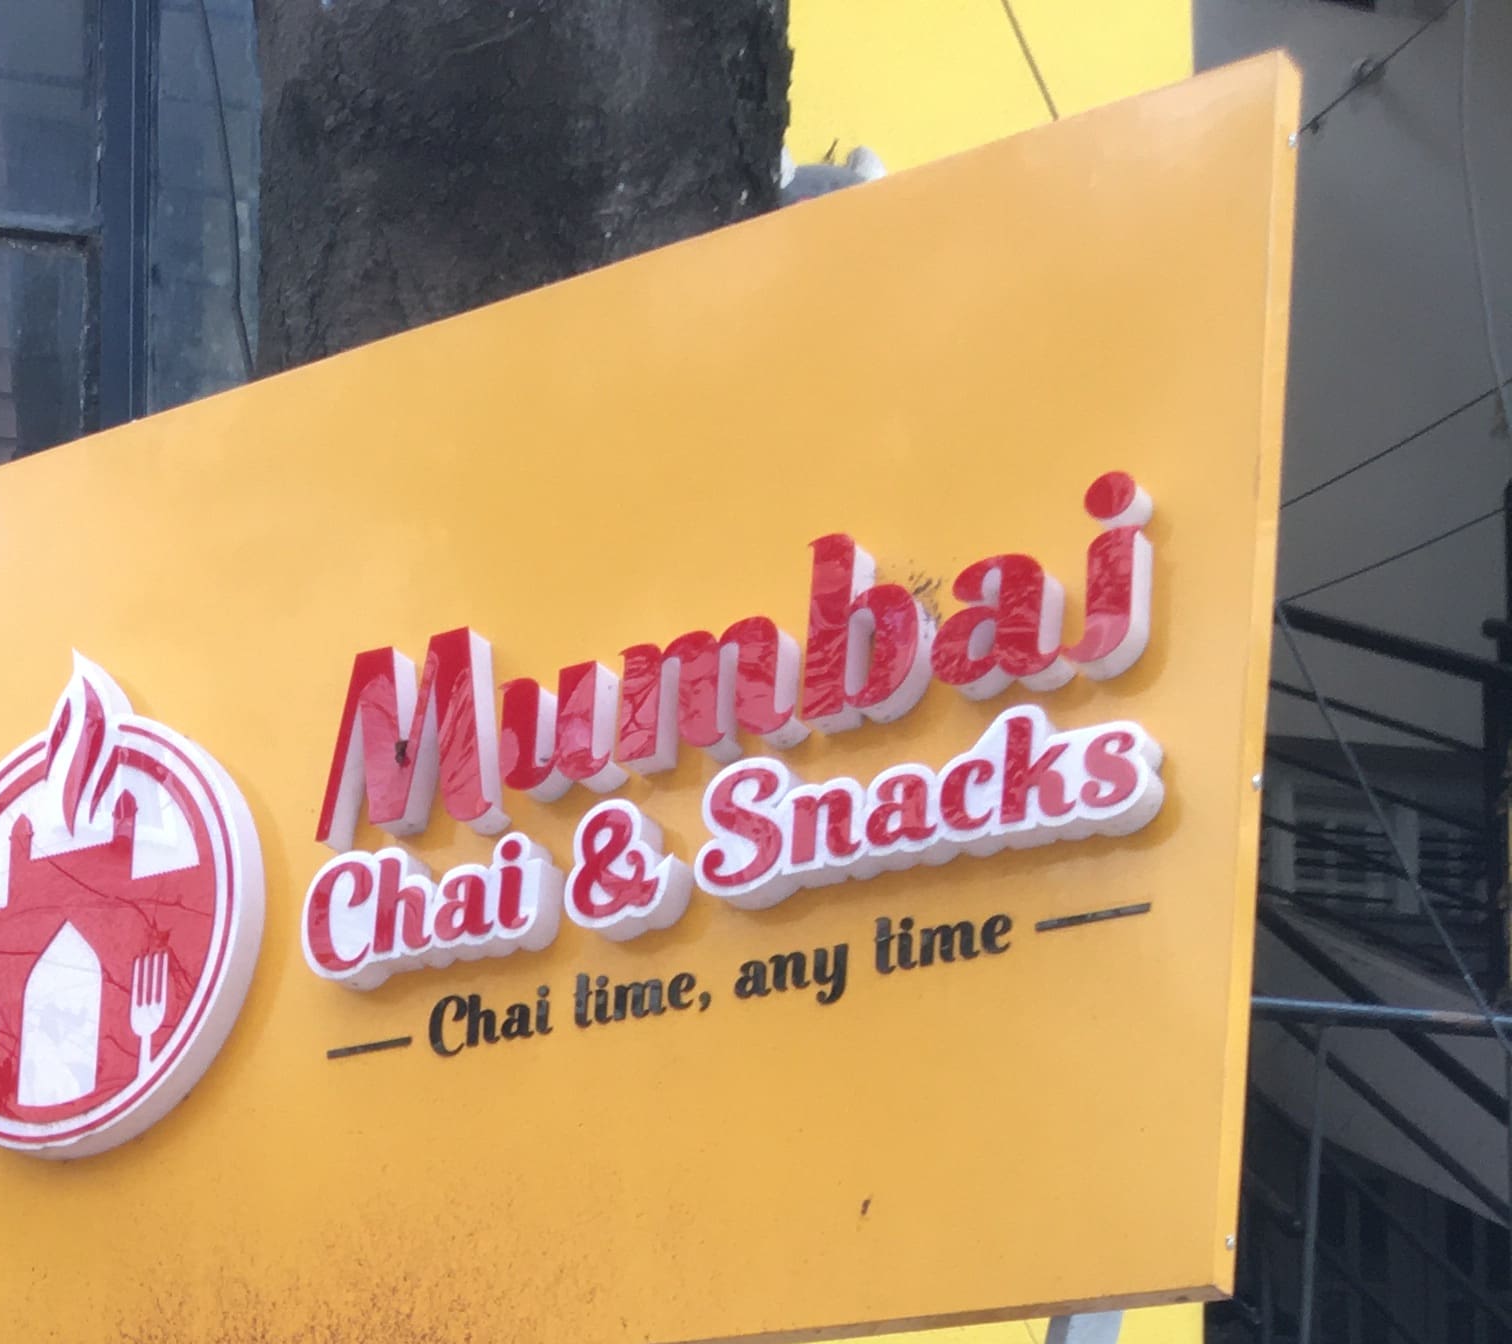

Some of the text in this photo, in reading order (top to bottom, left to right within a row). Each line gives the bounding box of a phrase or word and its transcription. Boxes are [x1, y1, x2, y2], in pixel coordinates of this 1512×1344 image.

[315, 470, 1146, 844] Mumbai
[304, 713, 1139, 974] Chai & Snacks
[428, 914, 1013, 1058] Chai time, any time
